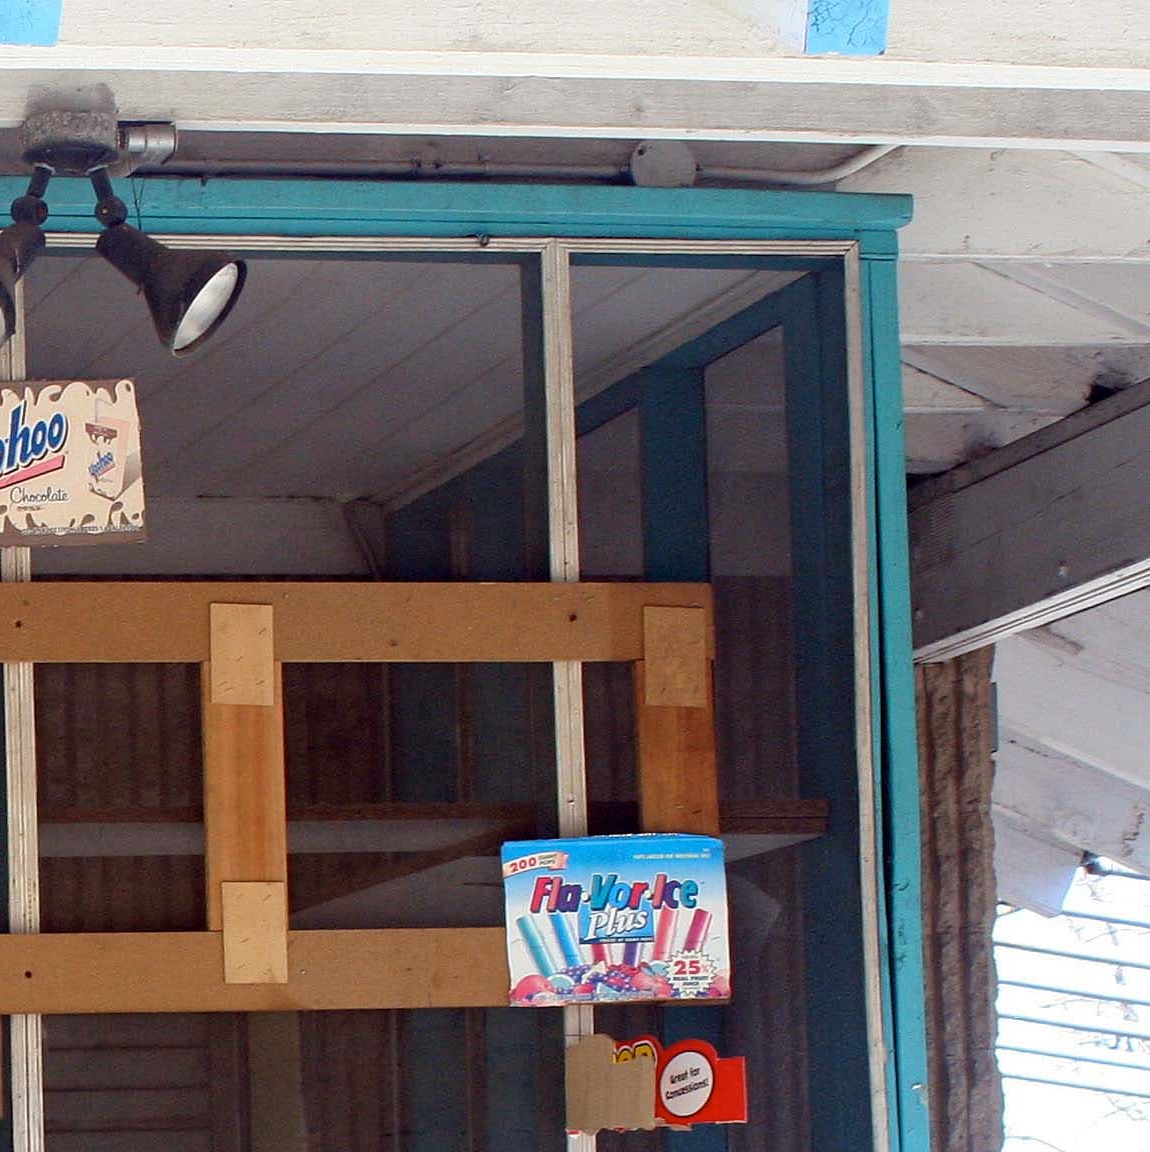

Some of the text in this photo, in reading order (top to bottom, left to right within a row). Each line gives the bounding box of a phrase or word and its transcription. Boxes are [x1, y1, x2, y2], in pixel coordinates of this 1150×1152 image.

[10, 485, 69, 504] Chocolate
[510, 857, 537, 873] 200
[583, 908, 648, 941] Plus
